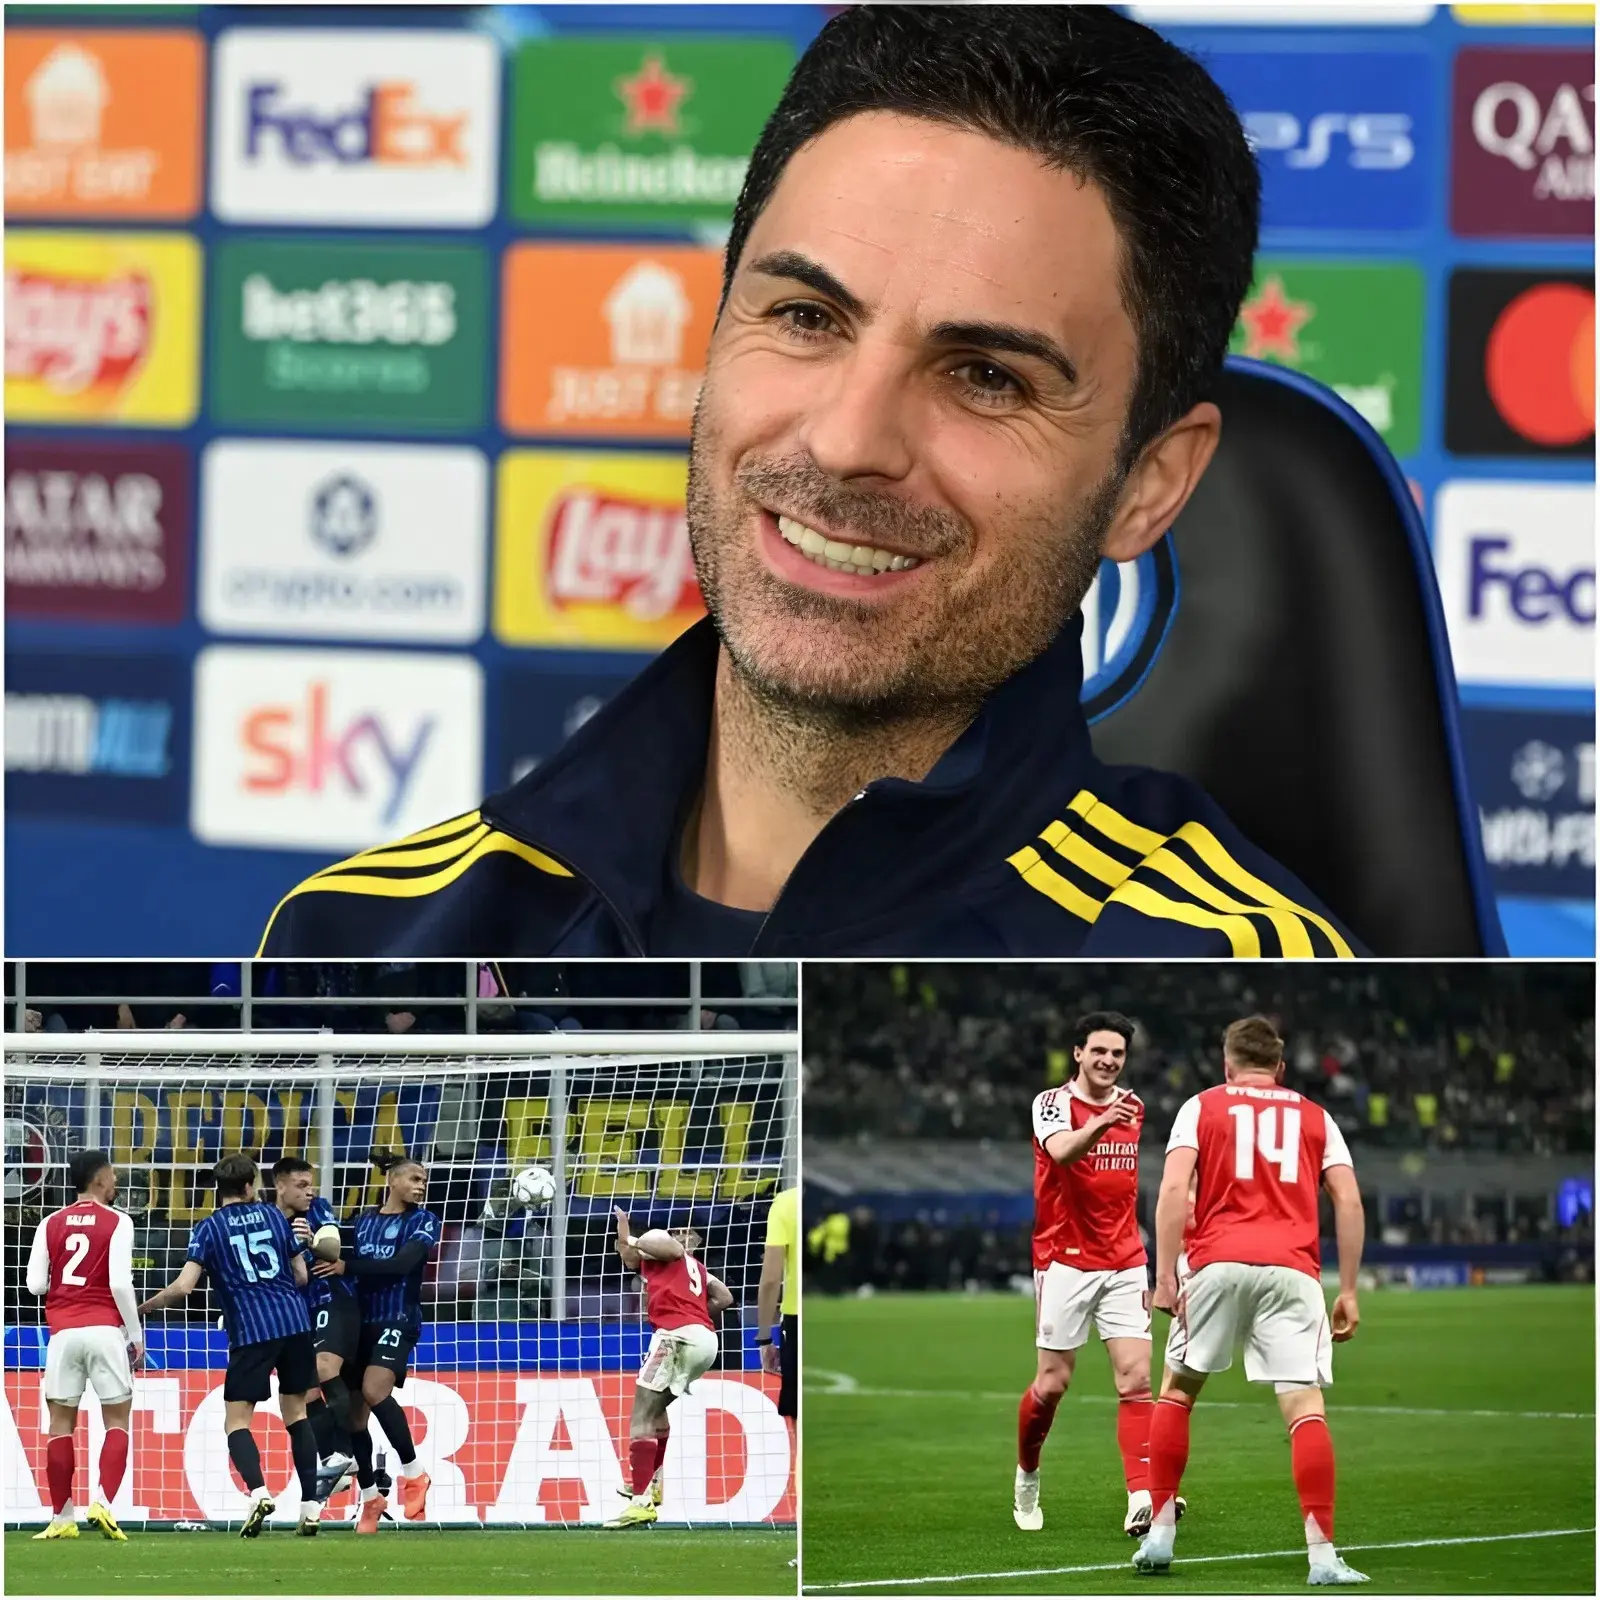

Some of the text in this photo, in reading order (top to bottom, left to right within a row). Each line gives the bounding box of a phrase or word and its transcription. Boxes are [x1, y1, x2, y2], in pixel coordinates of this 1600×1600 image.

[247, 83, 470, 164] FedEx
[1241, 111, 1414, 169] PS5
[1472, 81, 1595, 170] QA
[242, 272, 457, 345] bet365
[240, 683, 437, 828] sky
[1227, 1103, 1302, 1183] 14
[61, 1233, 90, 1286] 2
[229, 1229, 280, 1283] 15
[684, 1252, 703, 1297] 9
